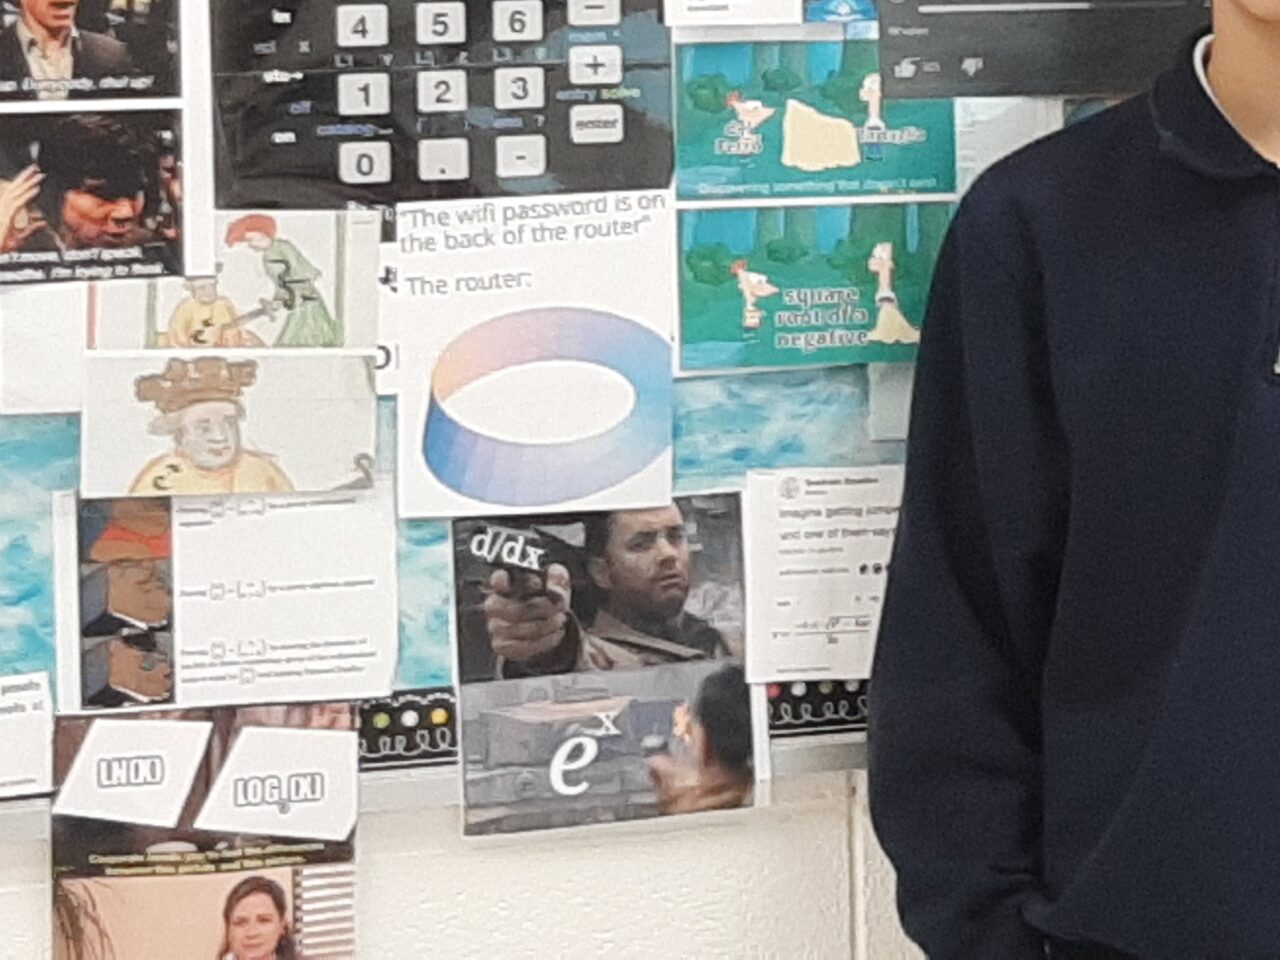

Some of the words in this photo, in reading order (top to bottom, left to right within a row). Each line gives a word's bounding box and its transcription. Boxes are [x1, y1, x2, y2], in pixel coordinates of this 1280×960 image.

[352, 16, 369, 40] 4
[431, 12, 449, 36] 5
[509, 10, 527, 34] 6
[434, 80, 451, 104] 2
[511, 76, 529, 100] 3
[355, 152, 374, 177] 0
[502, 195, 608, 226] password
[614, 194, 633, 212] is
[401, 233, 438, 254] the
[444, 227, 497, 251] back
[502, 223, 526, 245] of
[531, 222, 568, 242] the
[405, 275, 449, 296] The
[470, 525, 546, 571] d/dx
